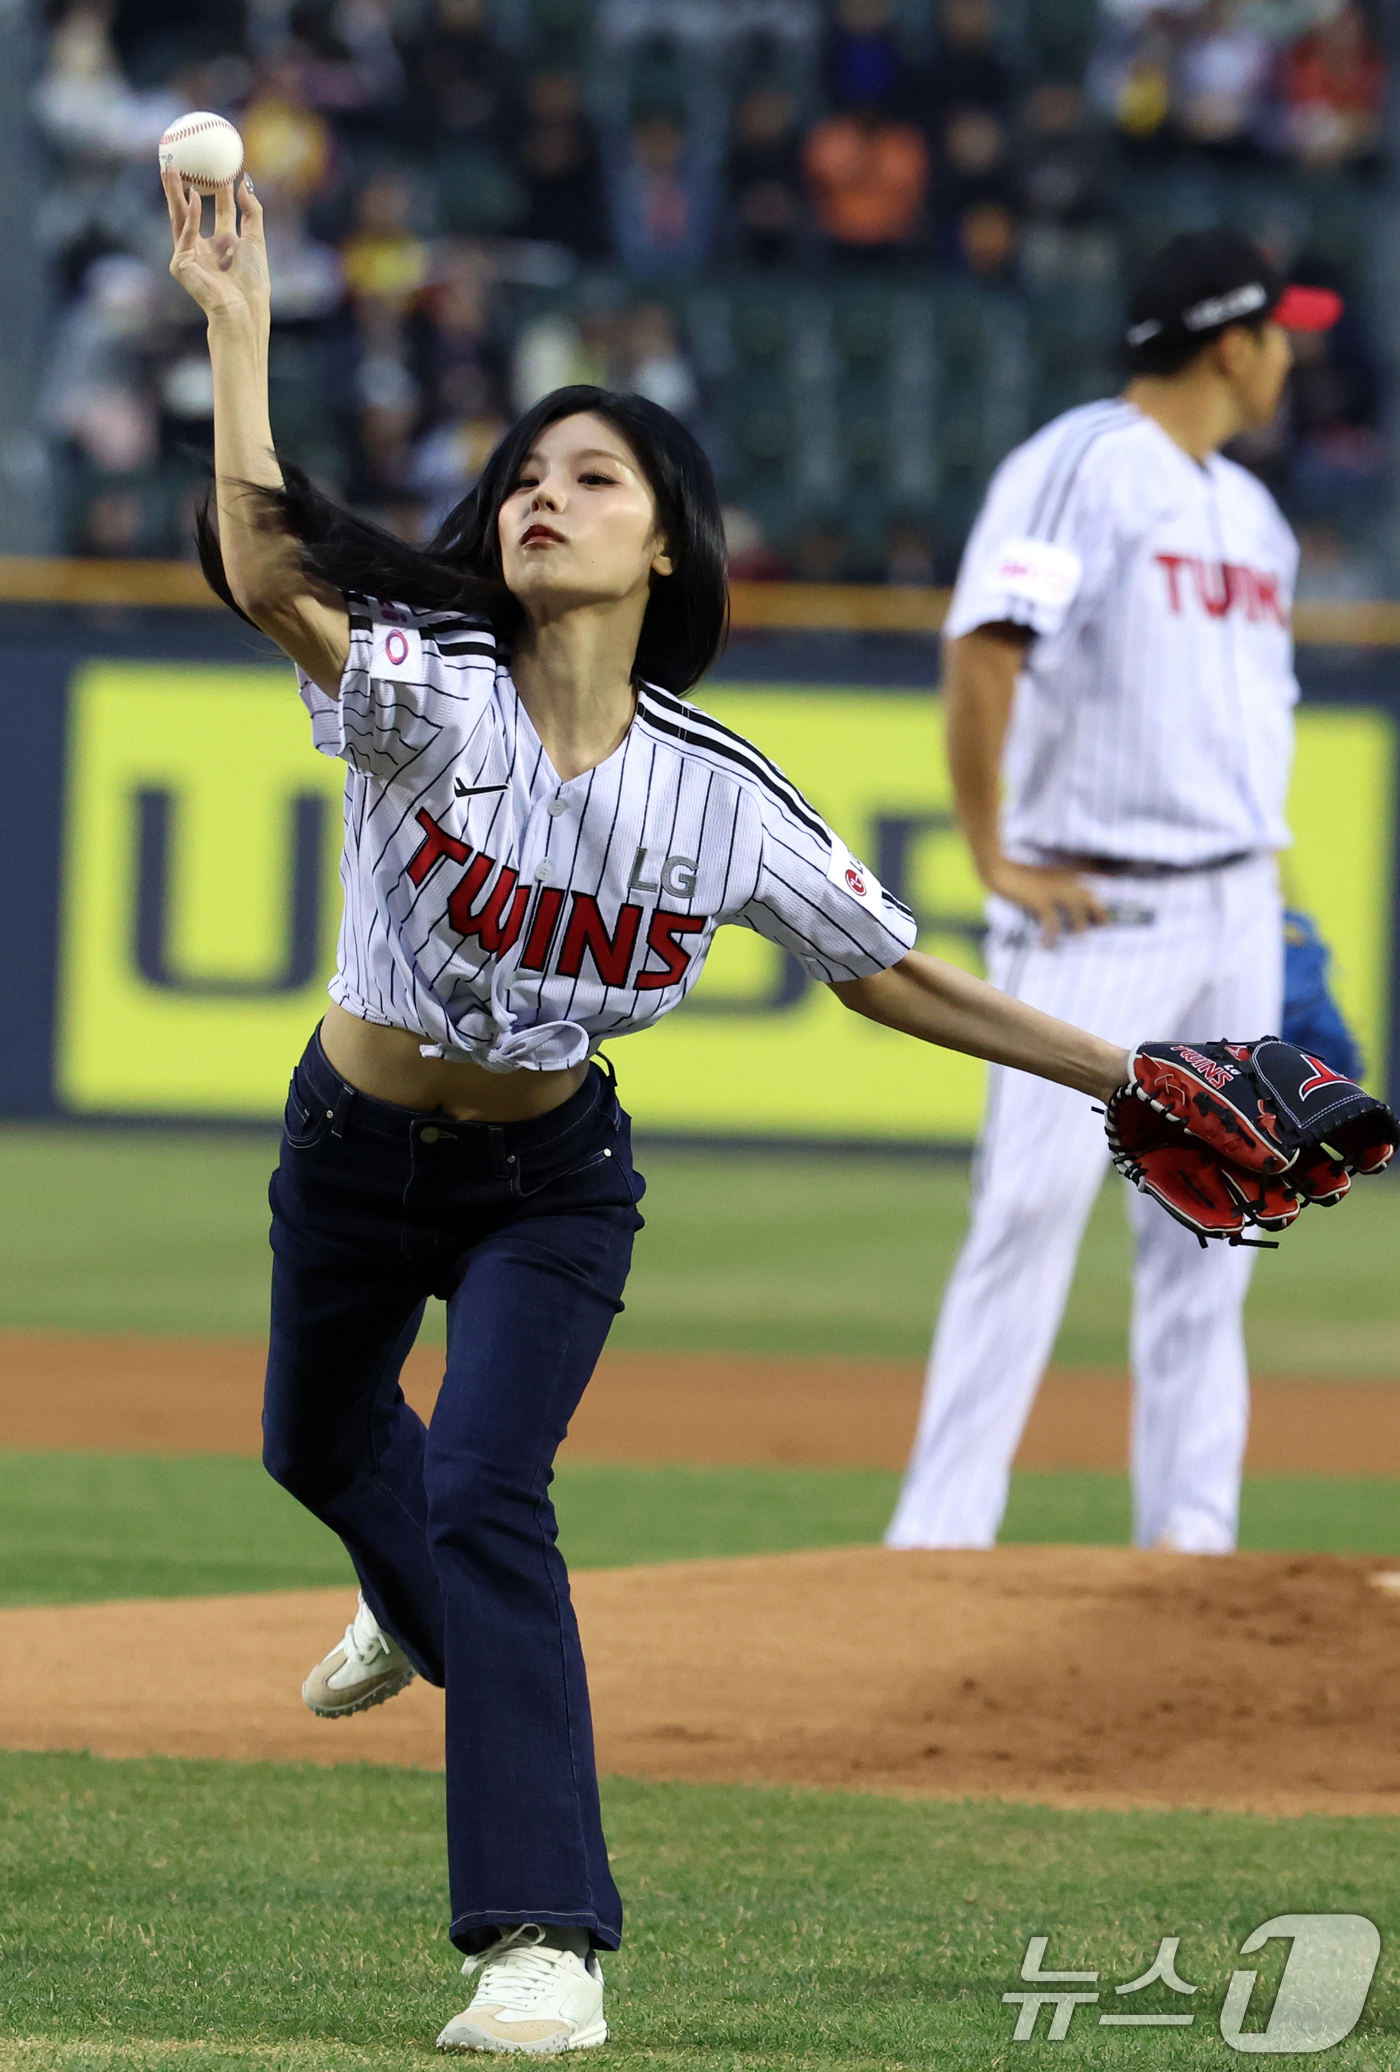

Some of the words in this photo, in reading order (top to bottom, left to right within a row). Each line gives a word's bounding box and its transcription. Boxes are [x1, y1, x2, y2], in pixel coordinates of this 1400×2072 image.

[406, 806, 708, 990] TWINS
[627, 846, 699, 899] LG
[1170, 1045, 1234, 1090] TWINS
